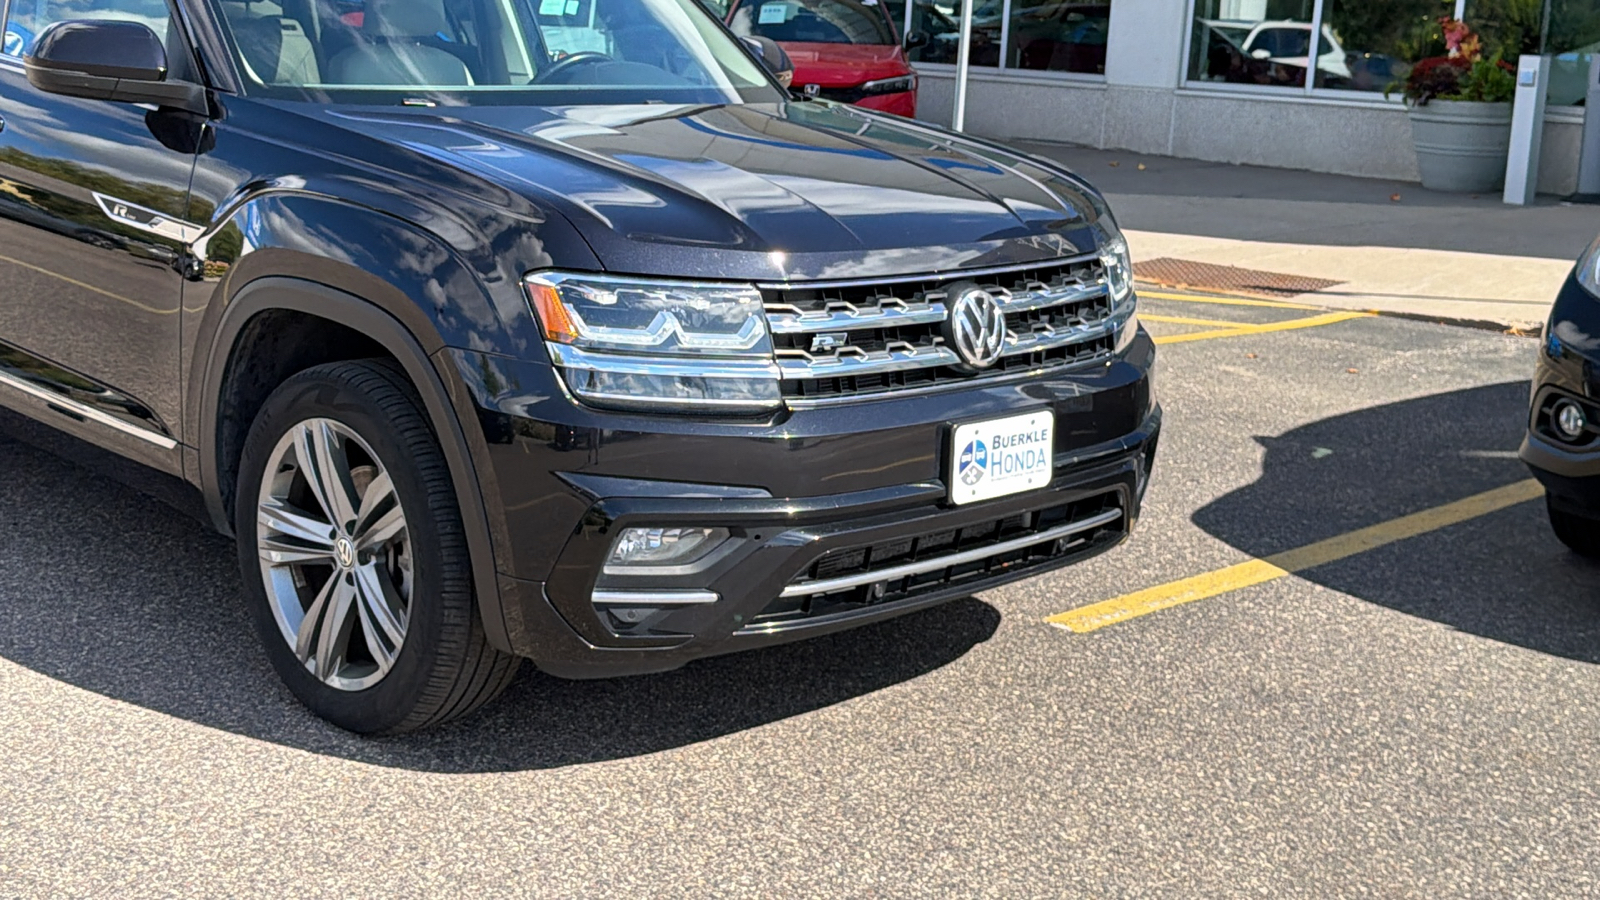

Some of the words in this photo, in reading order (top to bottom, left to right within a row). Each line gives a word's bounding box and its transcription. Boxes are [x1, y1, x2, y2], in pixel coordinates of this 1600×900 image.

[113, 204, 128, 217] R
[810, 336, 834, 351] R
[992, 429, 1048, 450] BUERKLE
[991, 448, 1047, 477] HONDA
